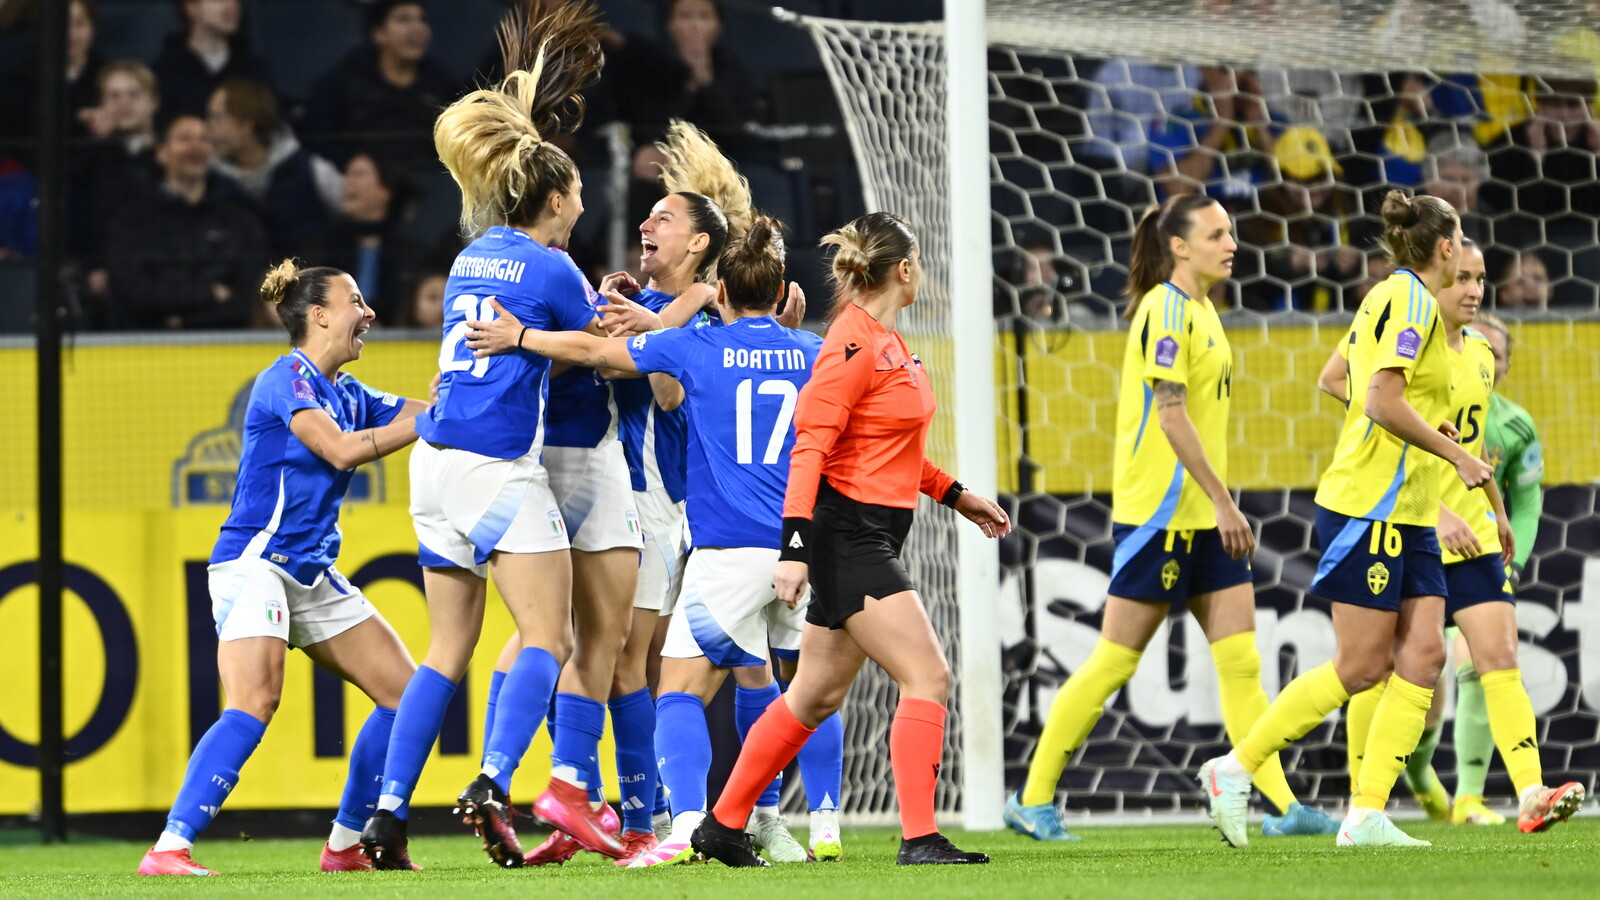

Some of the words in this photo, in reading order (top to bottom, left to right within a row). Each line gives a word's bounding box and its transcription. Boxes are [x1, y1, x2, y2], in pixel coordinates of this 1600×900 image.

[723, 347, 806, 370] BOATTIN
[736, 378, 798, 465] 17
[1369, 520, 1403, 557] 16
